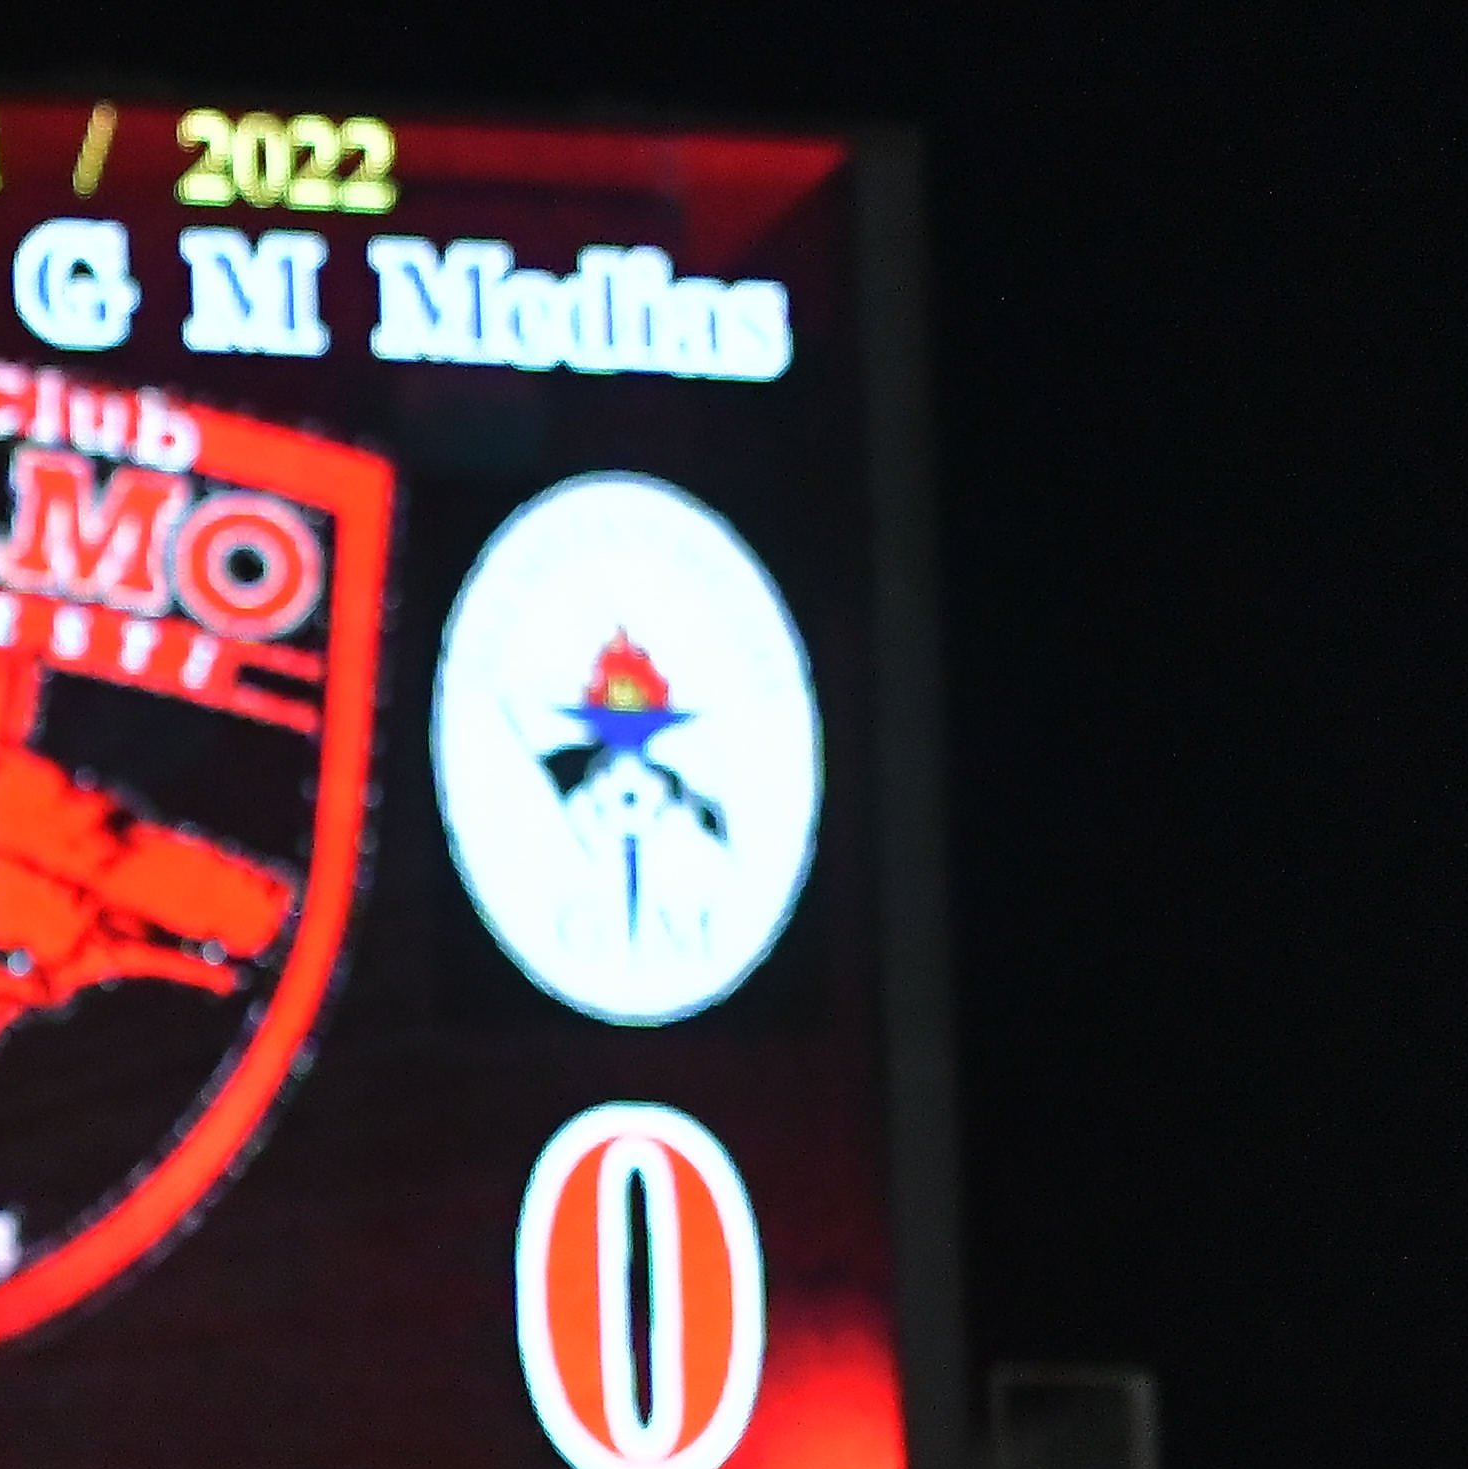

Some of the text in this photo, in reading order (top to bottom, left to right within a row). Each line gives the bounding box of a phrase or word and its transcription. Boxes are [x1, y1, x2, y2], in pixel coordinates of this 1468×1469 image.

[176, 107, 399, 214] 2022
[11, 216, 792, 383] G M Medias
